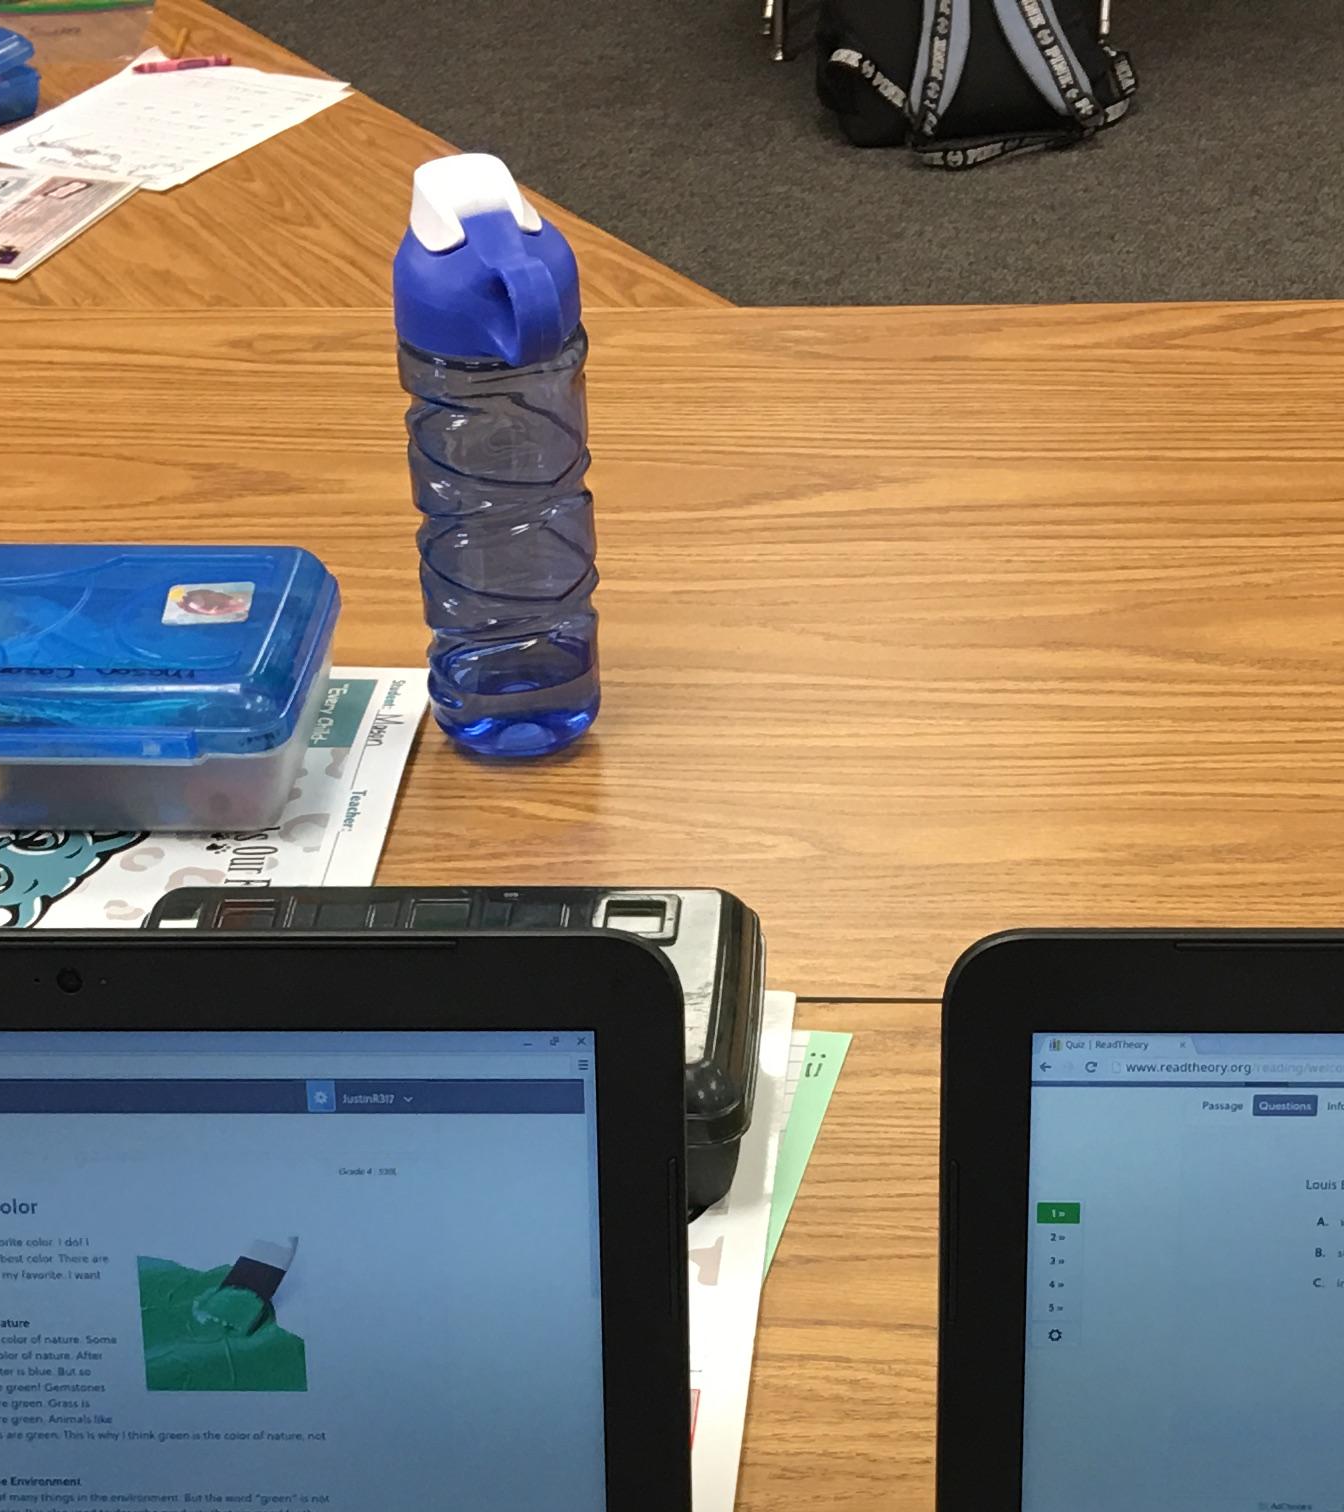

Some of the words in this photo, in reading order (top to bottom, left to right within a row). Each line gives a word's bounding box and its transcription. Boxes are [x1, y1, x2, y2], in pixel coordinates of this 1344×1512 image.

[365, 714, 404, 748] Mason
[341, 790, 367, 832] Teacher:
[228, 846, 279, 874] Our
[1065, 1040, 1085, 1050] Quiz
[1095, 1040, 1149, 1052] ReadTheory
[1202, 1102, 1244, 1114] Passage
[1258, 1101, 1312, 1114] Questions
[1306, 1179, 1337, 1190] Louis
[0, 1254, 23, 1263] best
[58, 1254, 89, 1263] There
[1, 1335, 28, 1345] color
[31, 1335, 42, 1345] of
[85, 1335, 117, 1345] Some
[11, 1476, 82, 1487] Environment
